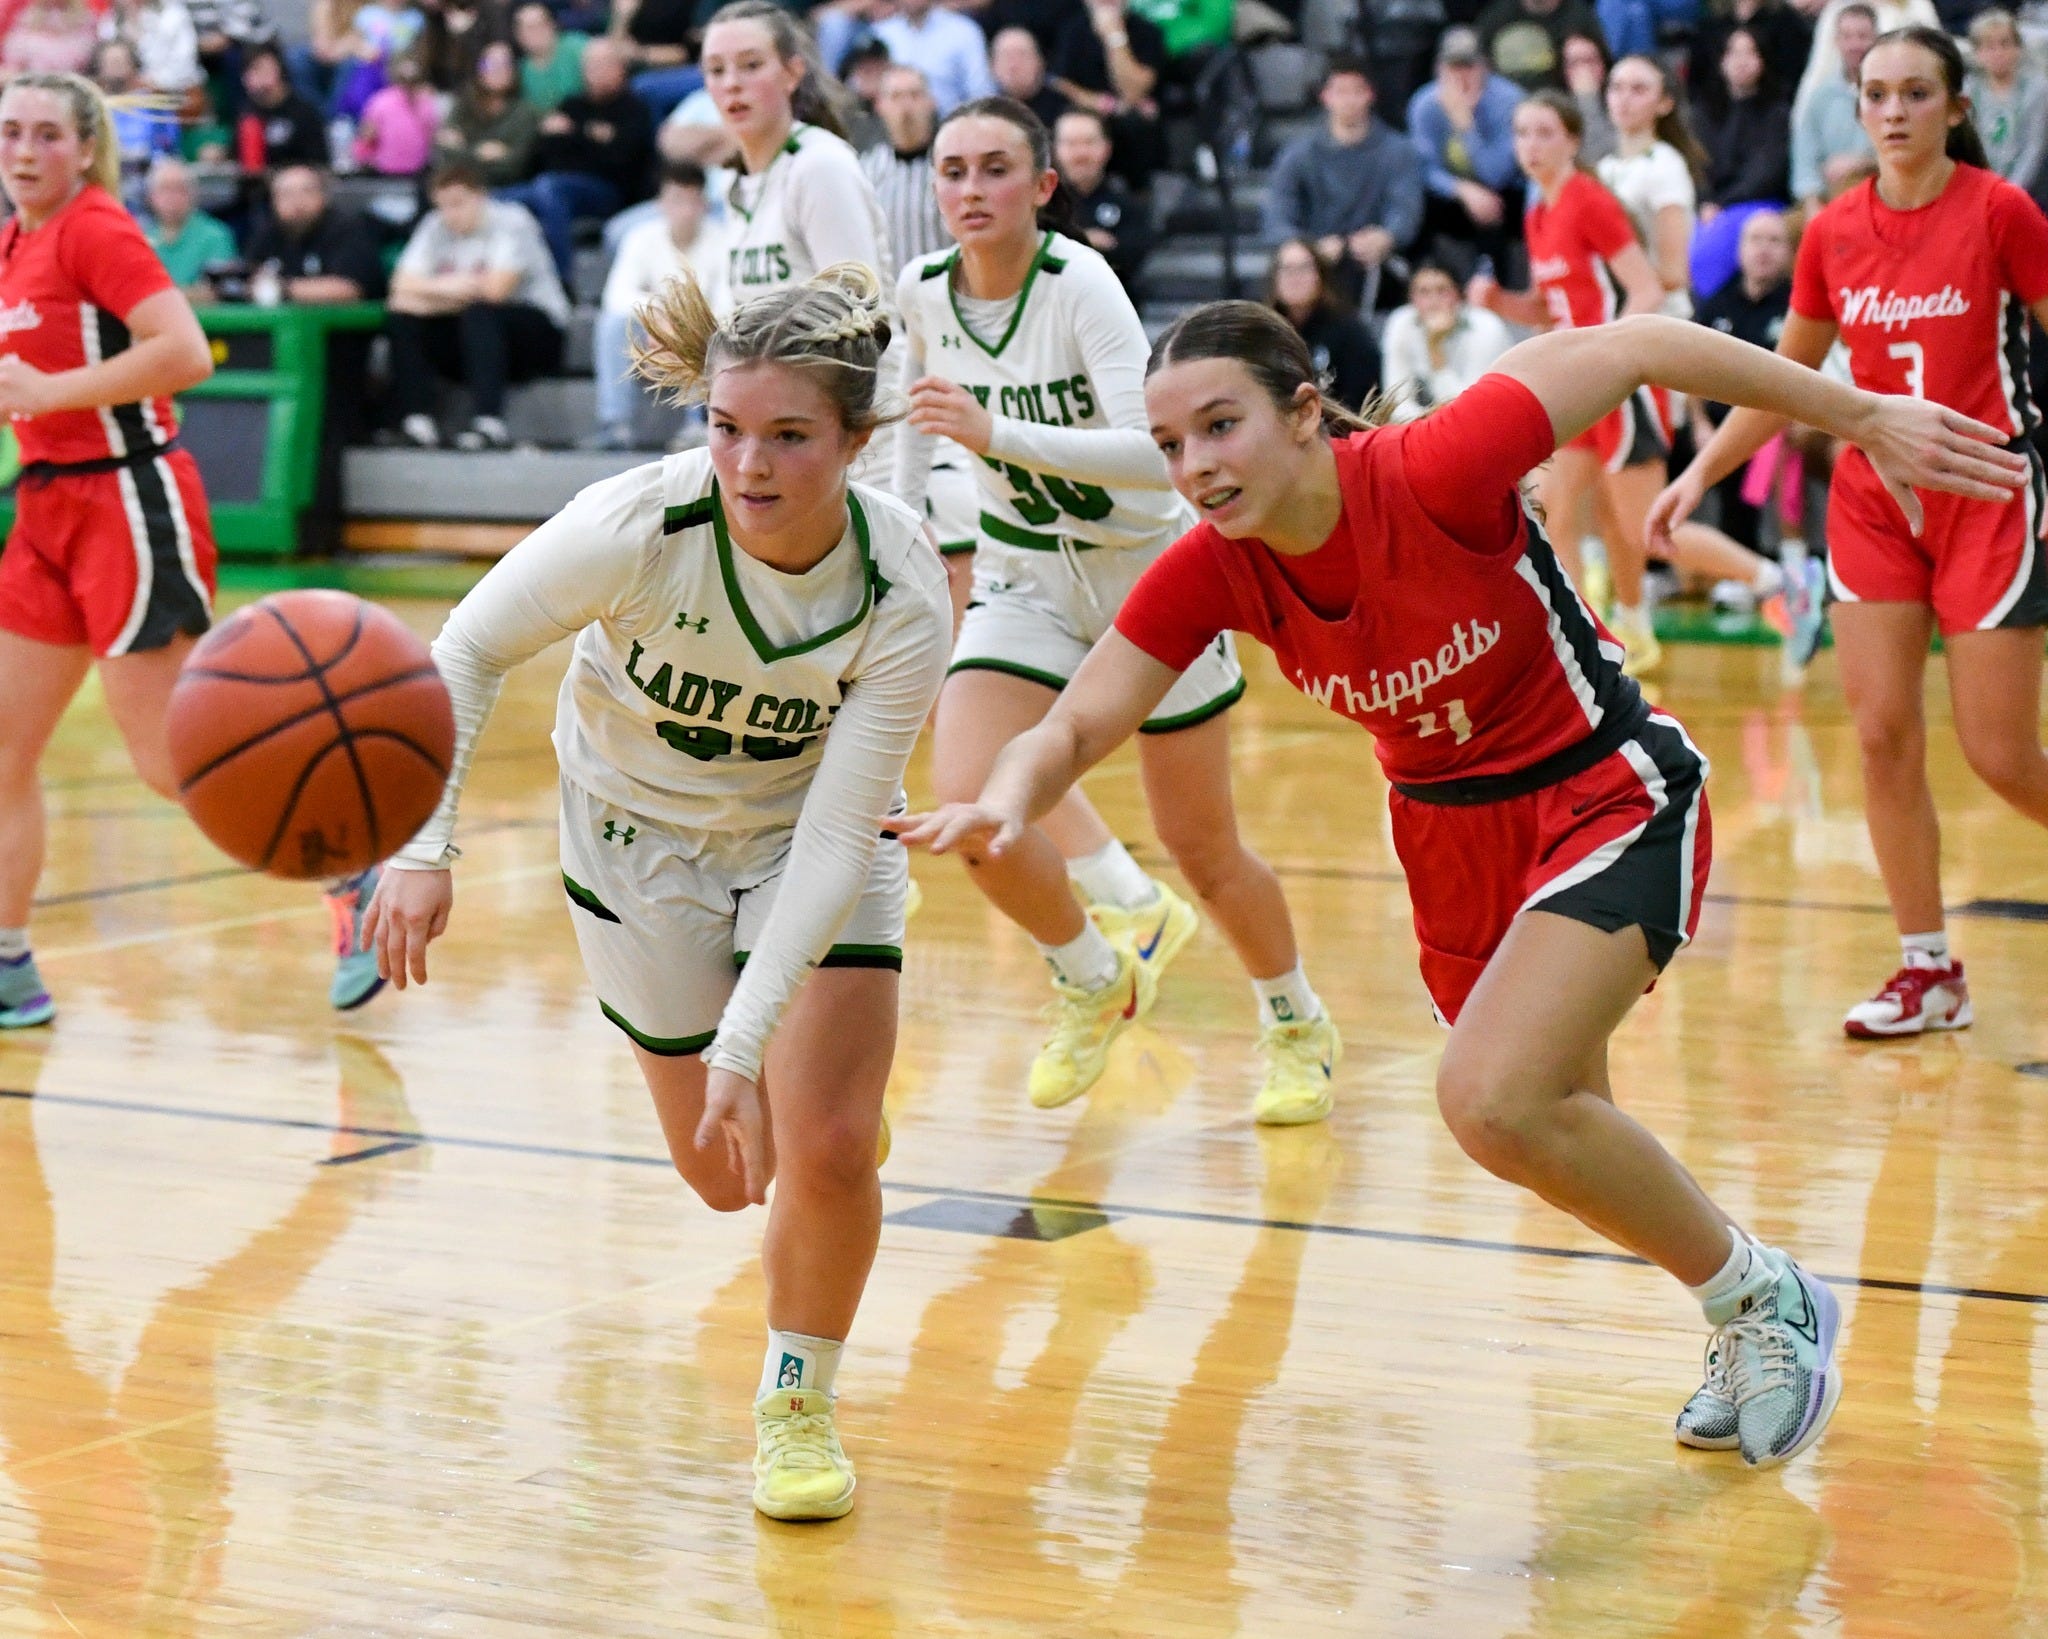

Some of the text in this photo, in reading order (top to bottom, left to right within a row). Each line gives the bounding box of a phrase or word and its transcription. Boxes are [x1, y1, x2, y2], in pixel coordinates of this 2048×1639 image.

[1840, 284, 1971, 333] Whippets
[1888, 341, 1925, 399] 3
[1001, 374, 1095, 427] COLTS
[625, 639, 742, 722] LADY
[1296, 618, 1501, 716] Whippets
